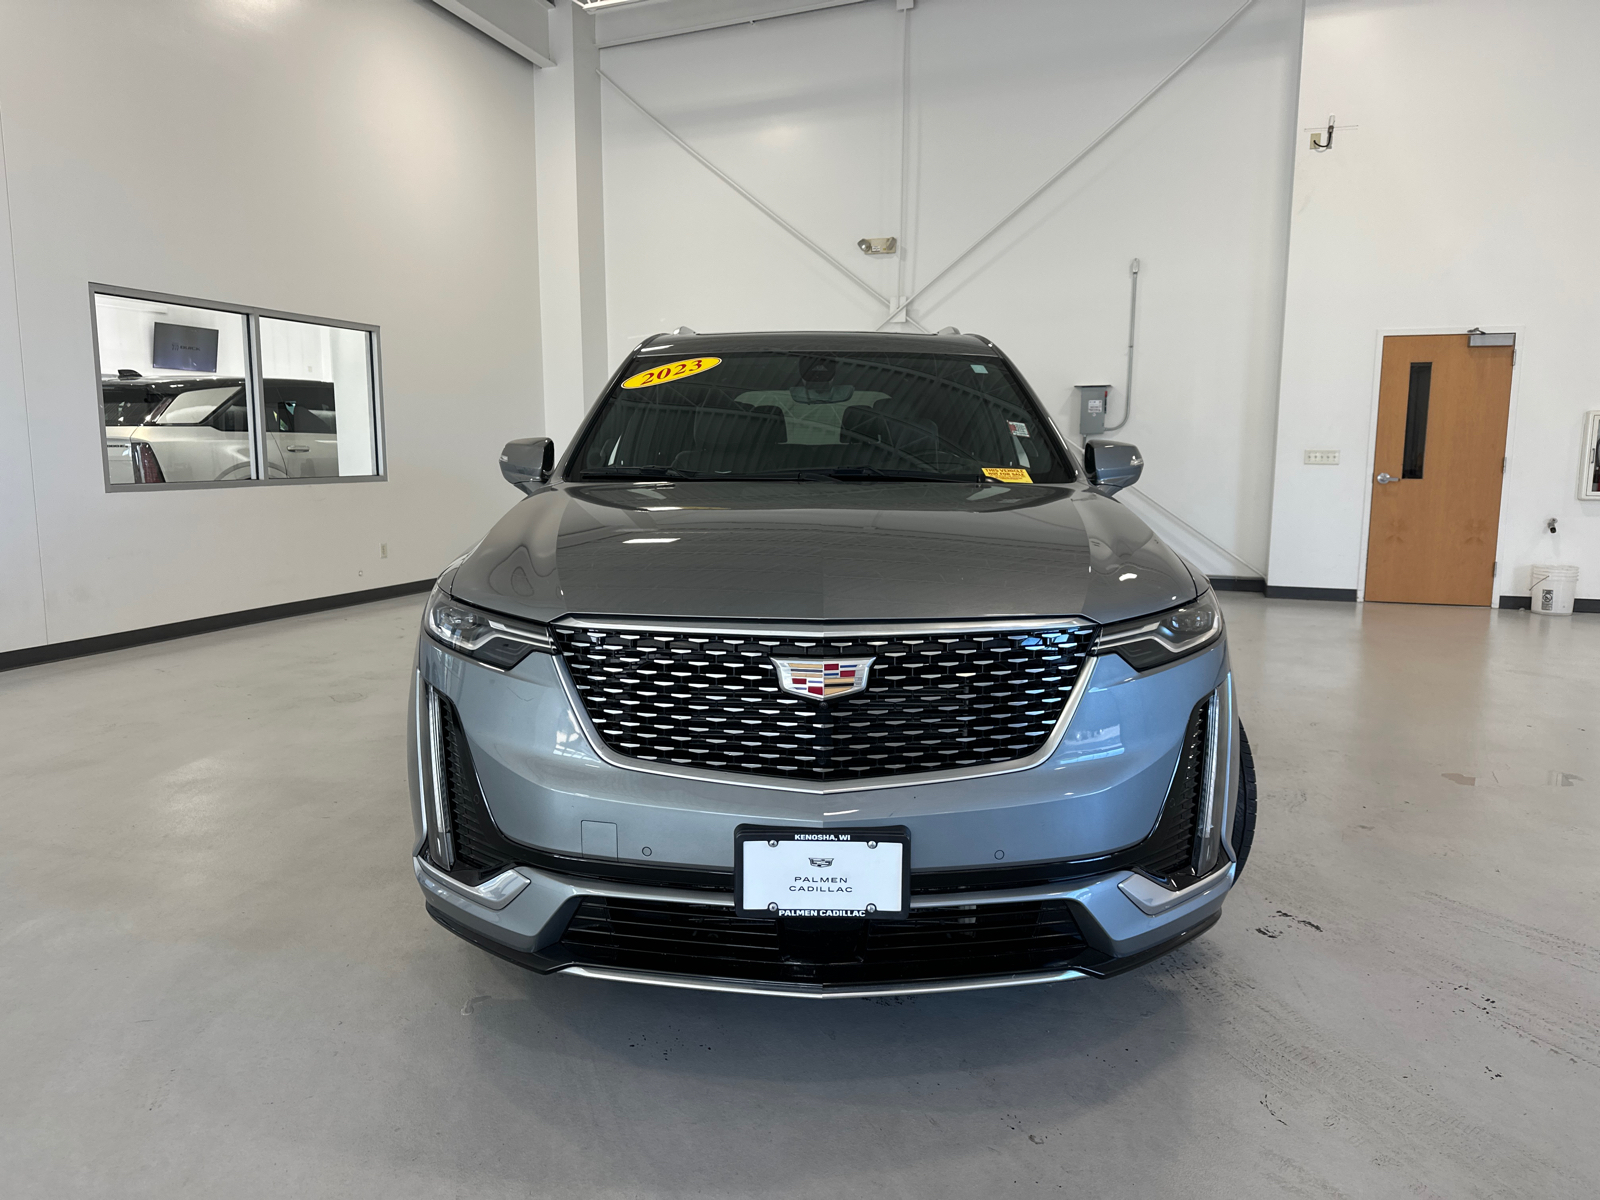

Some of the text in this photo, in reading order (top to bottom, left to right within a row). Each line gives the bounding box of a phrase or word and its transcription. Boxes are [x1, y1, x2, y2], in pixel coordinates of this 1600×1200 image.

[640, 360, 703, 386] 2023
[794, 876, 848, 884] PALMEN
[788, 885, 853, 893] CADILLAC
[778, 909, 818, 917] PALMEN
